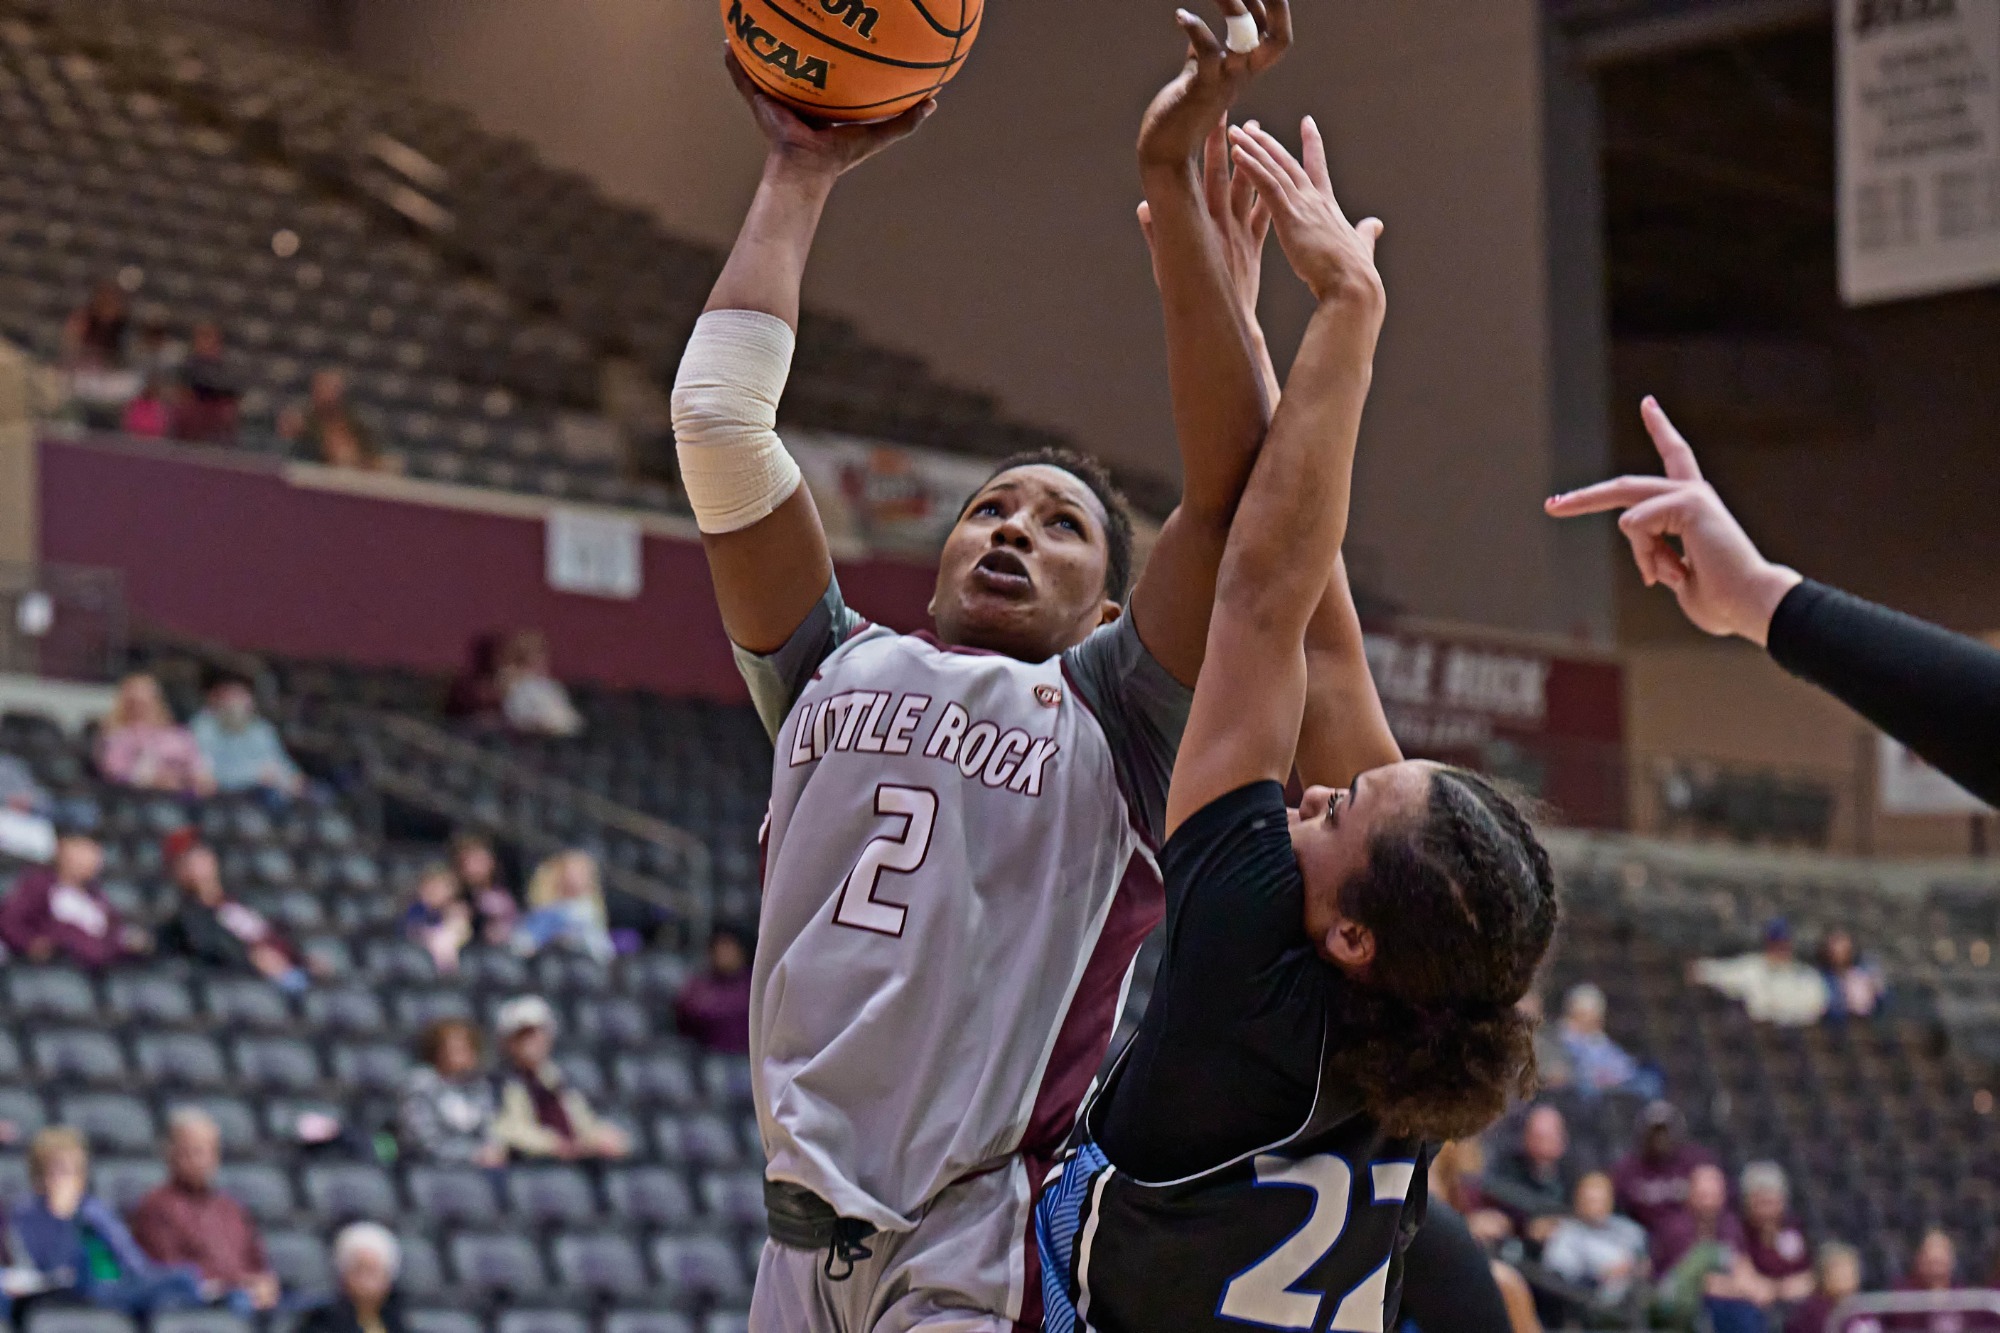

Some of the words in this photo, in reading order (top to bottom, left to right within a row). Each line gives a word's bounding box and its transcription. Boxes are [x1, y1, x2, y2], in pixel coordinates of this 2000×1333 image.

[727, 0, 830, 90] NCAA
[789, 689, 932, 768] LITTLE
[923, 701, 1060, 797] ROCK
[832, 782, 939, 938] 2
